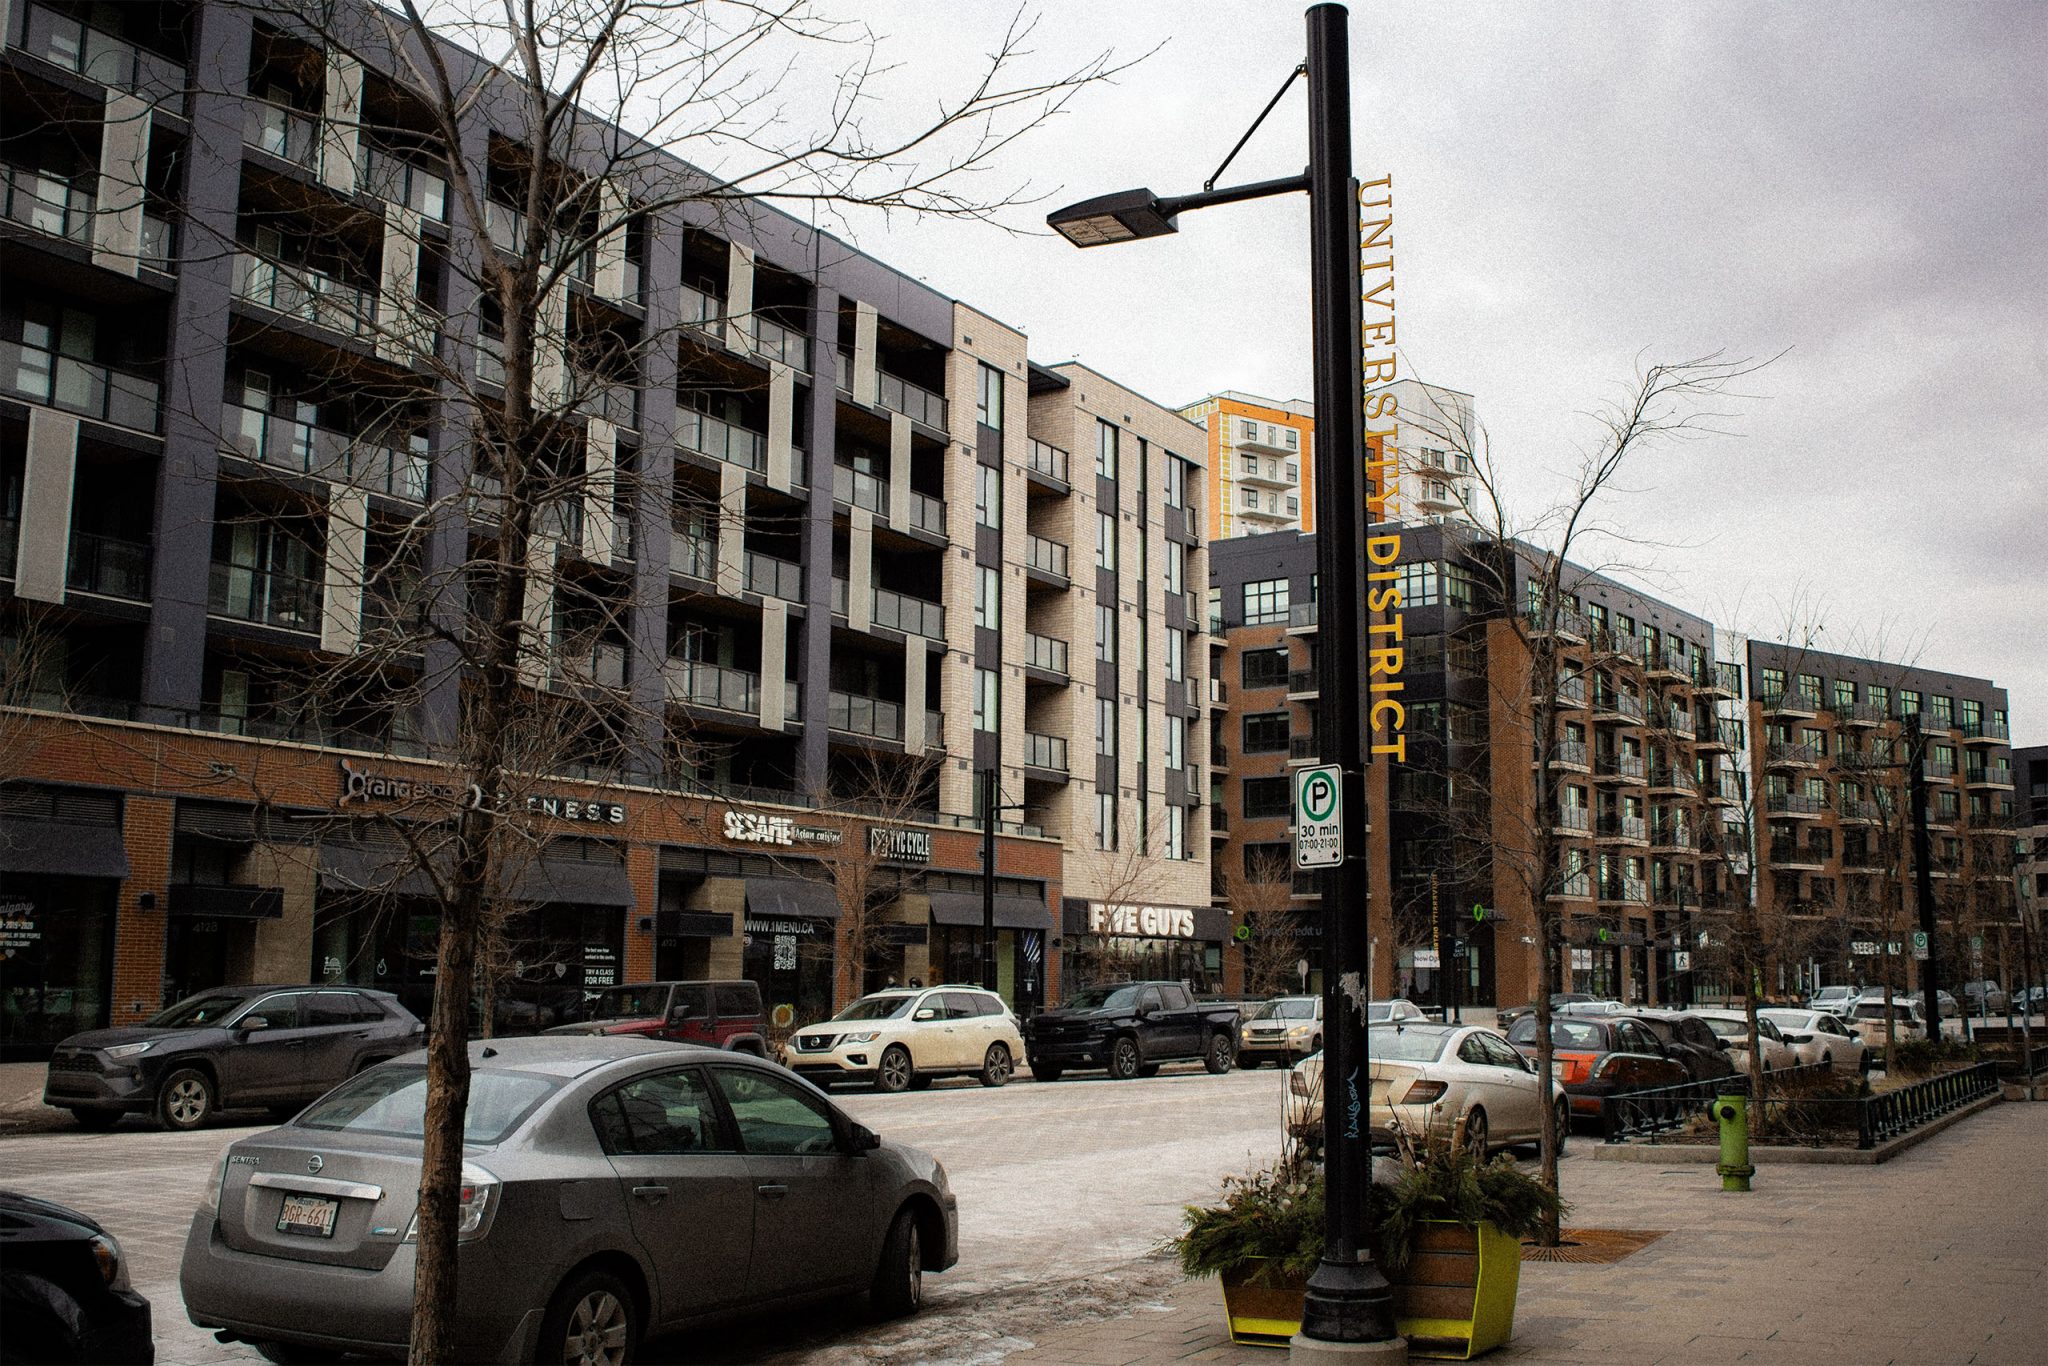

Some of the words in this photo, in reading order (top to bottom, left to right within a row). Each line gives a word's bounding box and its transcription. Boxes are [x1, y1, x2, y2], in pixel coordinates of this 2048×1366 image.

[1357, 173, 1400, 516] UNIVERSITY
[1367, 534, 1406, 763] DISTRICT
[496, 792, 624, 823] TNESS
[1312, 781, 1329, 811] P
[723, 811, 793, 845] SESAME
[889, 830, 906, 853] YYC
[907, 832, 930, 855] CYCLE
[1301, 825, 1315, 837] 30
[1320, 823, 1338, 836] min
[744, 919, 815, 934] WWW.1MENU.CA
[1140, 906, 1195, 937] GUYS
[1880, 942, 1902, 955] ALT
[231, 1156, 260, 1165] SENTRA
